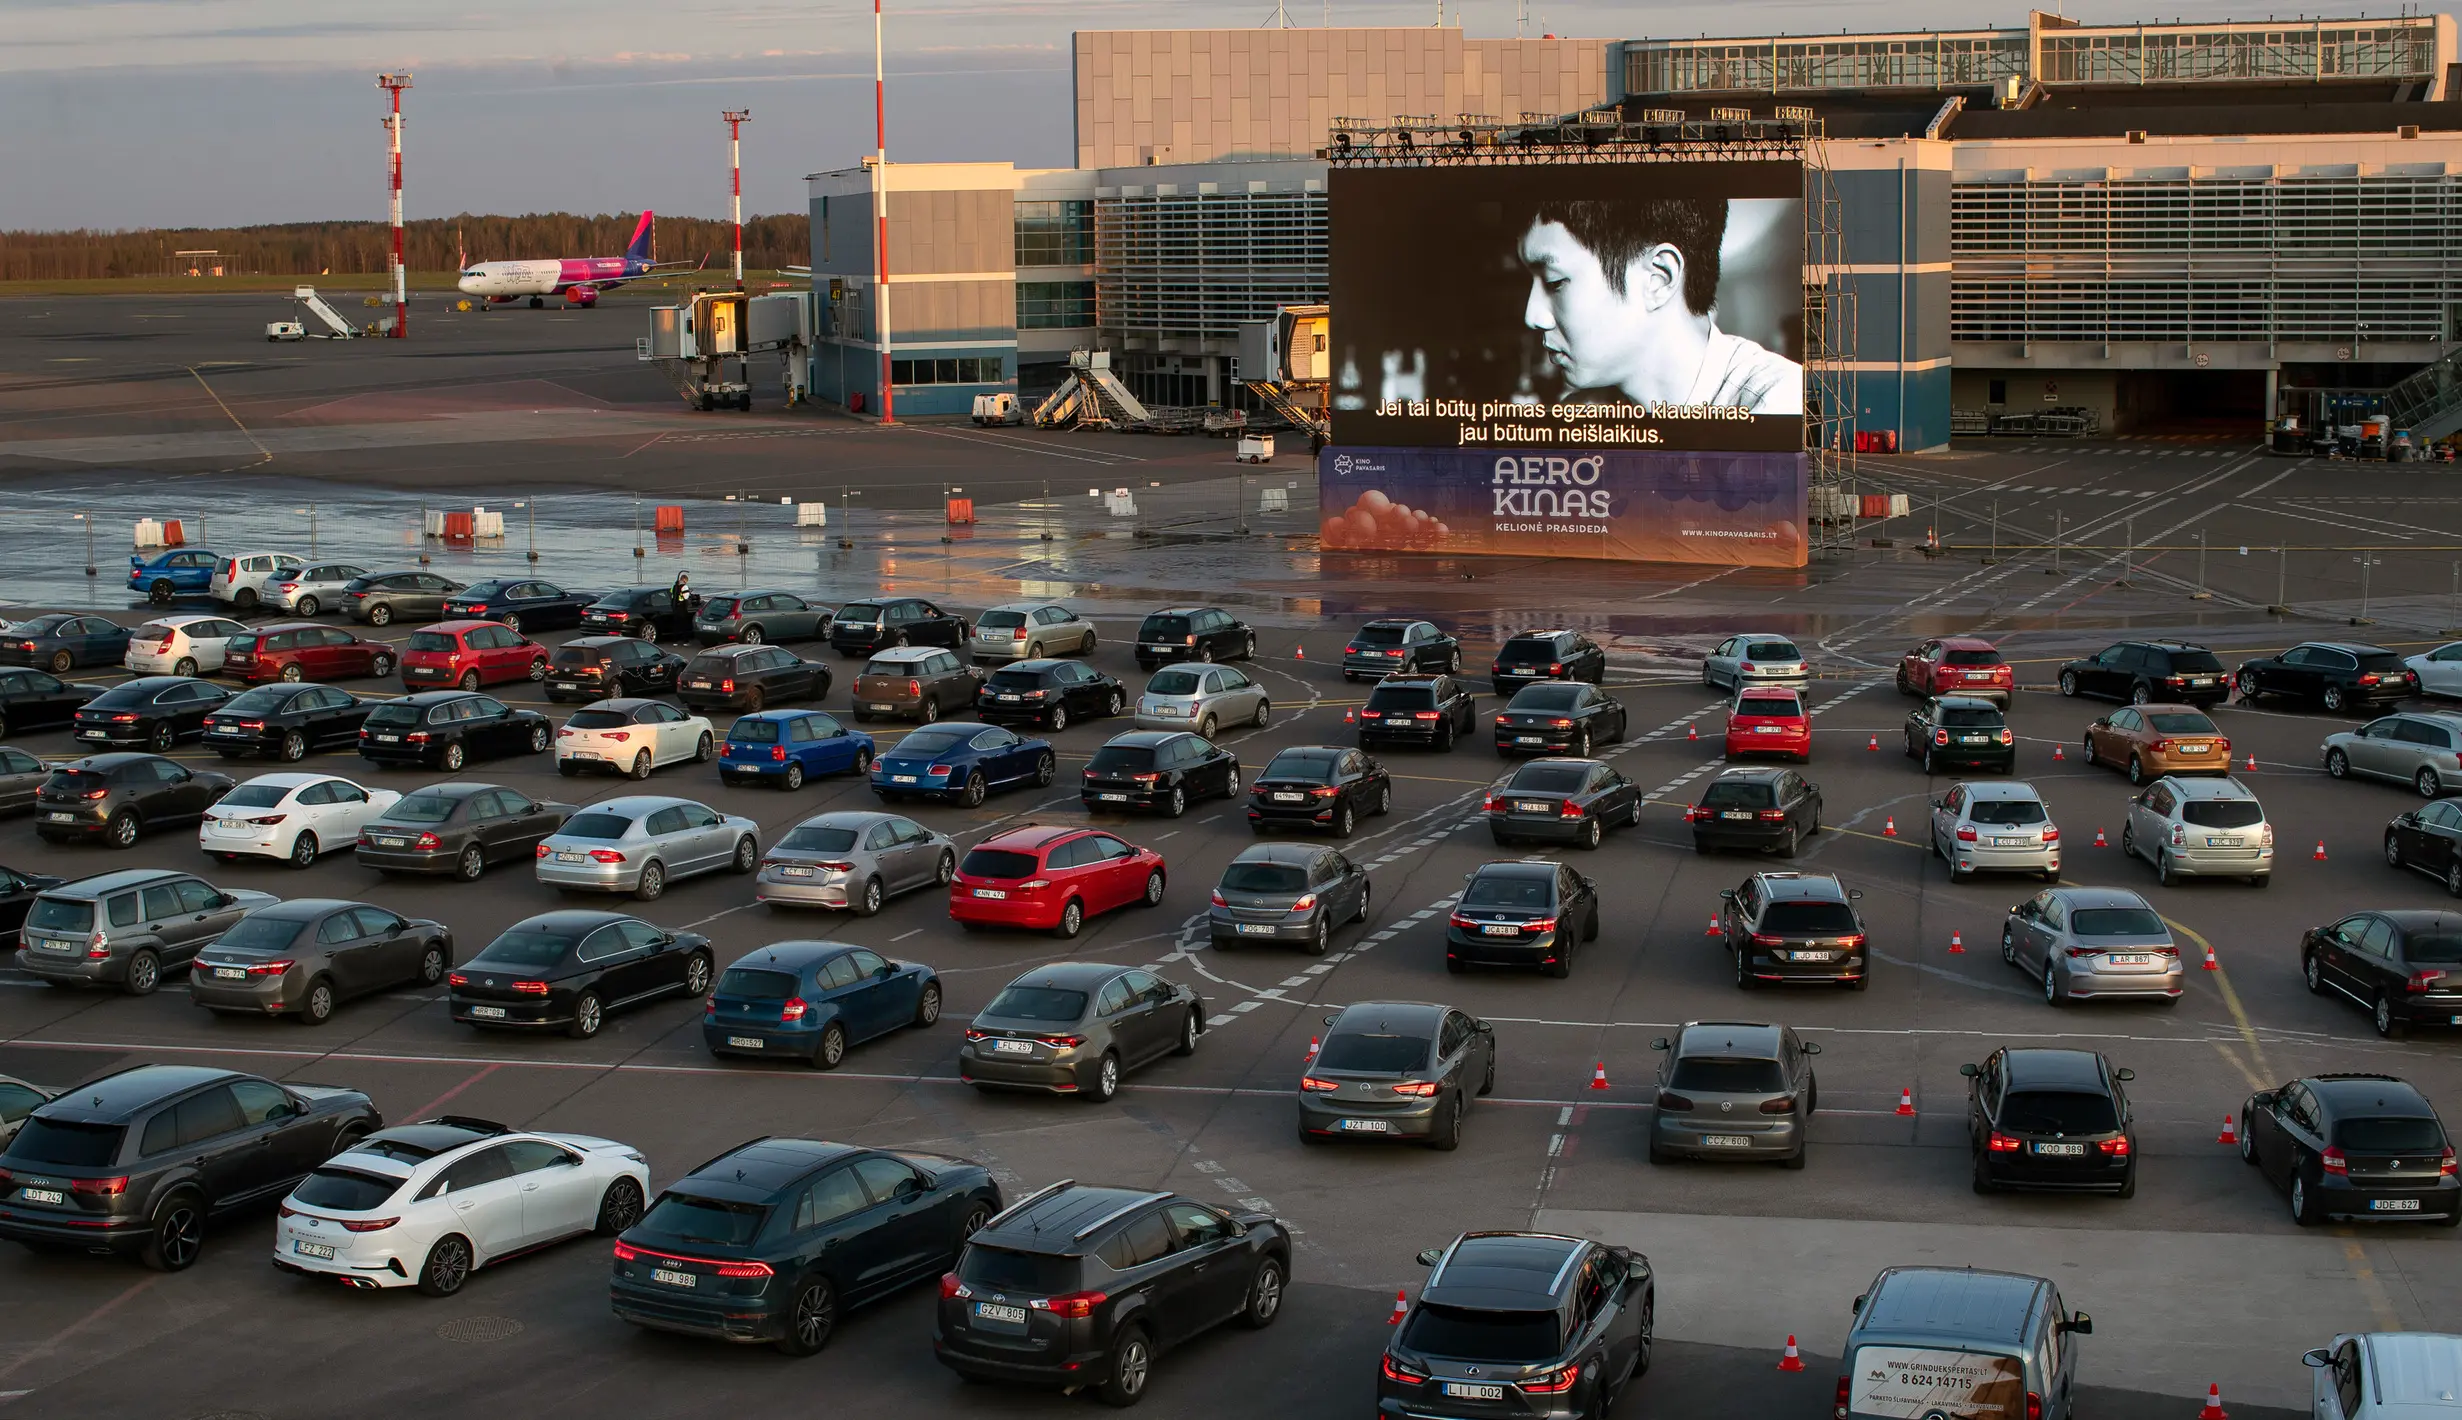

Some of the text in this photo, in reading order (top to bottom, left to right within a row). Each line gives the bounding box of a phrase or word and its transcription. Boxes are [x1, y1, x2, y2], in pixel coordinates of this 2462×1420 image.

[831, 289, 841, 299] 47
[1376, 399, 1755, 423] Jei tai būtų pirmas egzamino klausimas,
[1459, 423, 1664, 445] jau būtum neišlaikius.
[1492, 455, 1604, 486] AERO
[1493, 488, 1611, 518] KINAS
[1495, 521, 1609, 534] KELIONĖ PRASIDEDA
[1681, 529, 1778, 539] WWW.KINOPAVASARIS.LT
[1485, 925, 1518, 934] JCA 810
[1795, 951, 1828, 959] LJD 438
[2114, 955, 2147, 963] LAR 867
[749, 1038, 762, 1047] 527
[997, 1040, 1031, 1051] LFL 257
[1346, 1120, 1385, 1129] JZT 100
[1731, 1137, 1747, 1145] 600
[2064, 1145, 2082, 1153] 989
[26, 1189, 61, 1202] LDT 242
[2377, 1200, 2418, 1208] JDE 627
[299, 1243, 333, 1257] LFZ 222
[654, 1268, 694, 1286] KTD 989
[981, 1304, 1024, 1319] GZV 805
[1887, 1360, 1987, 1376] WWW.GRINDUEKSPERTAS.LT
[1901, 1373, 1972, 1389] 8 624 14715
[1480, 1386, 1501, 1398] 002
